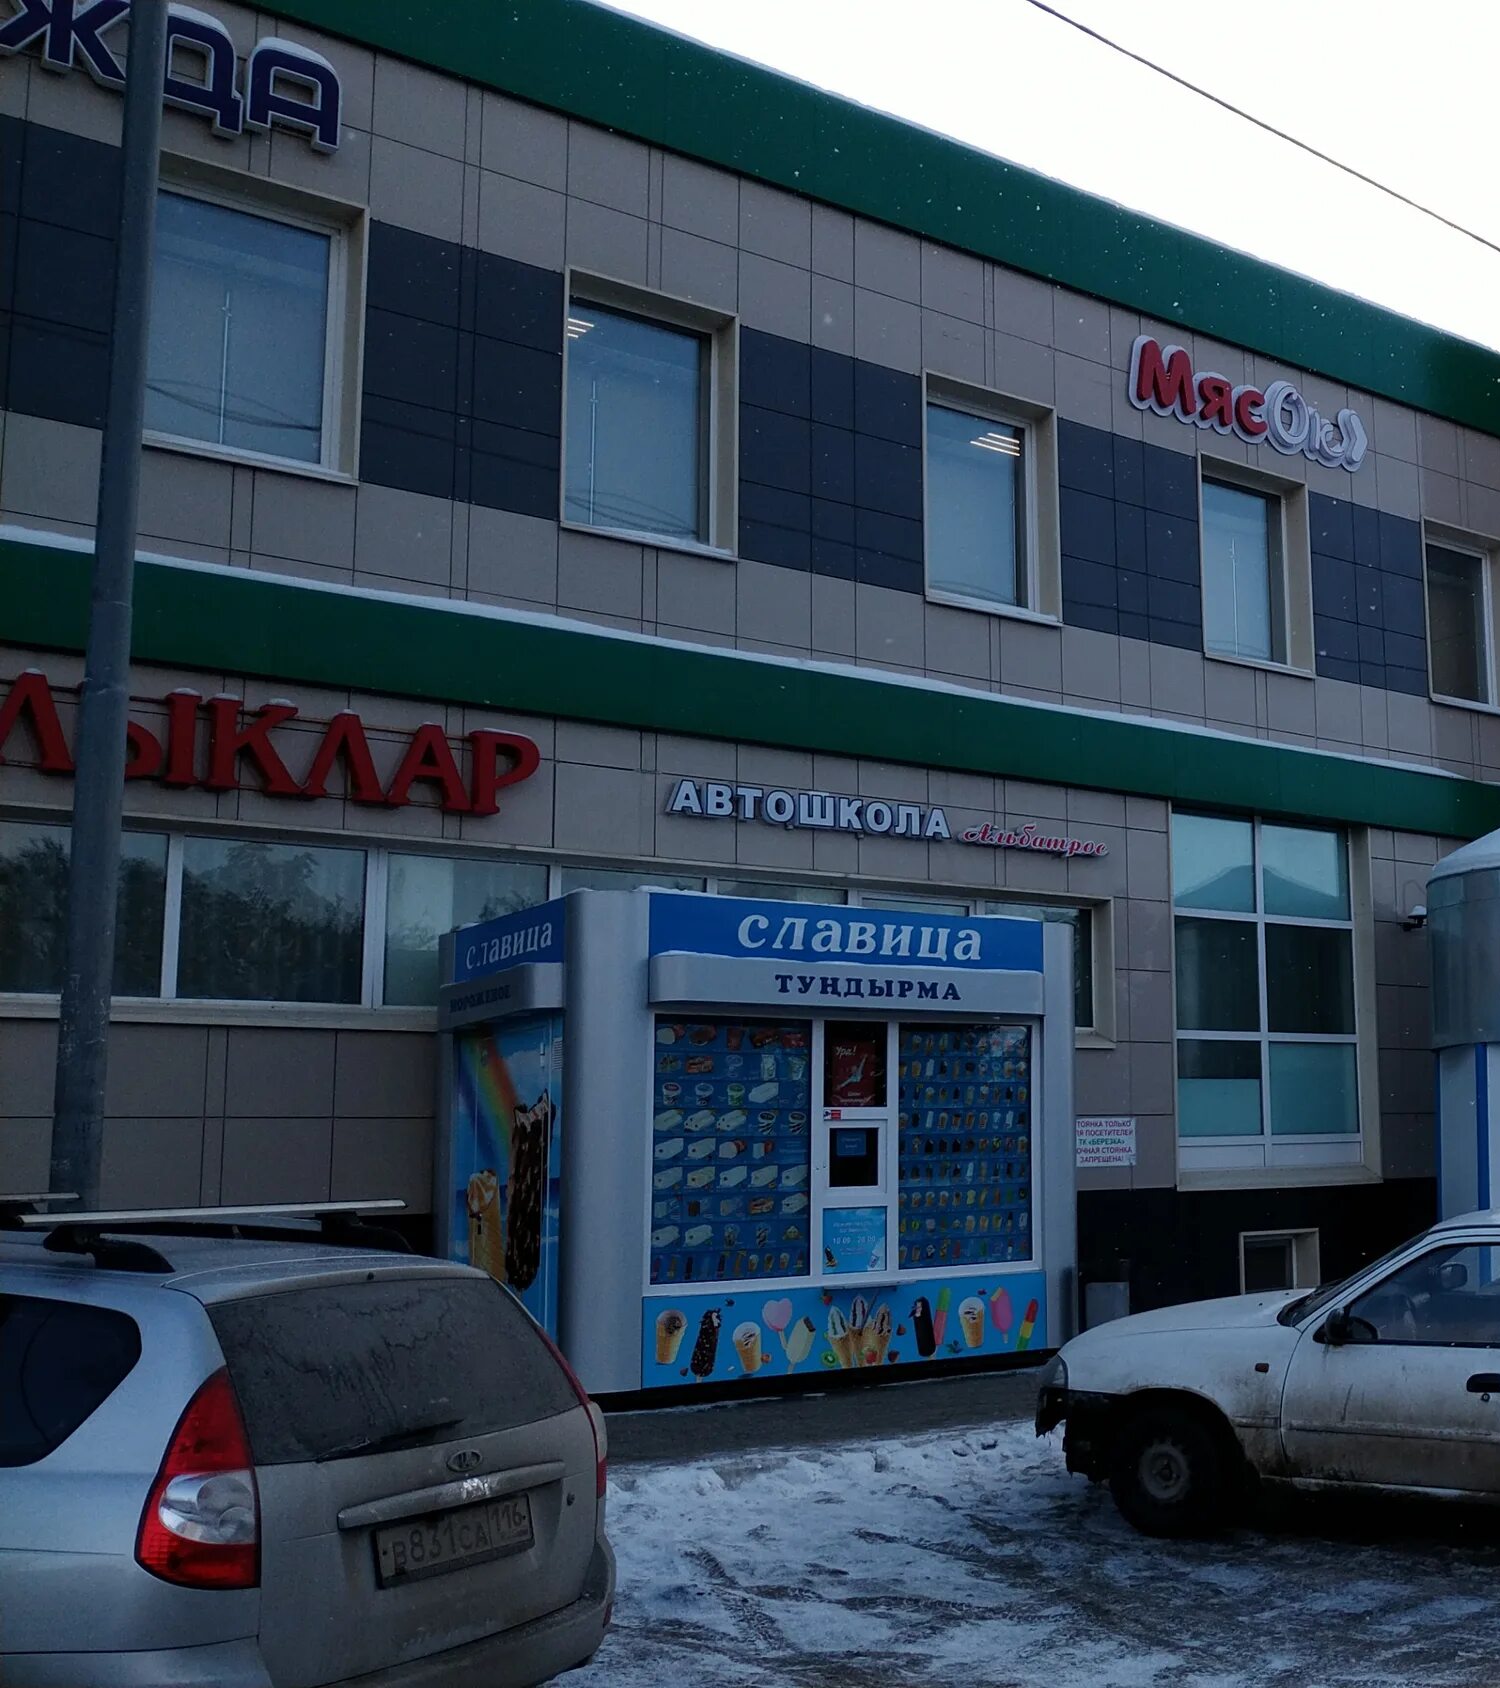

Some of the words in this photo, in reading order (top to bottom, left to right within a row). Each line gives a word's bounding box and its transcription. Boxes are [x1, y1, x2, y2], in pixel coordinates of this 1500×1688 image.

[670, 779, 951, 839] АВТОШКОЛА
[961, 820, 1110, 859] Альбатрос
[1105, 1120, 1131, 1128] ТОЛЬКО
[1101, 1146, 1133, 1154] СТОЯНКА
